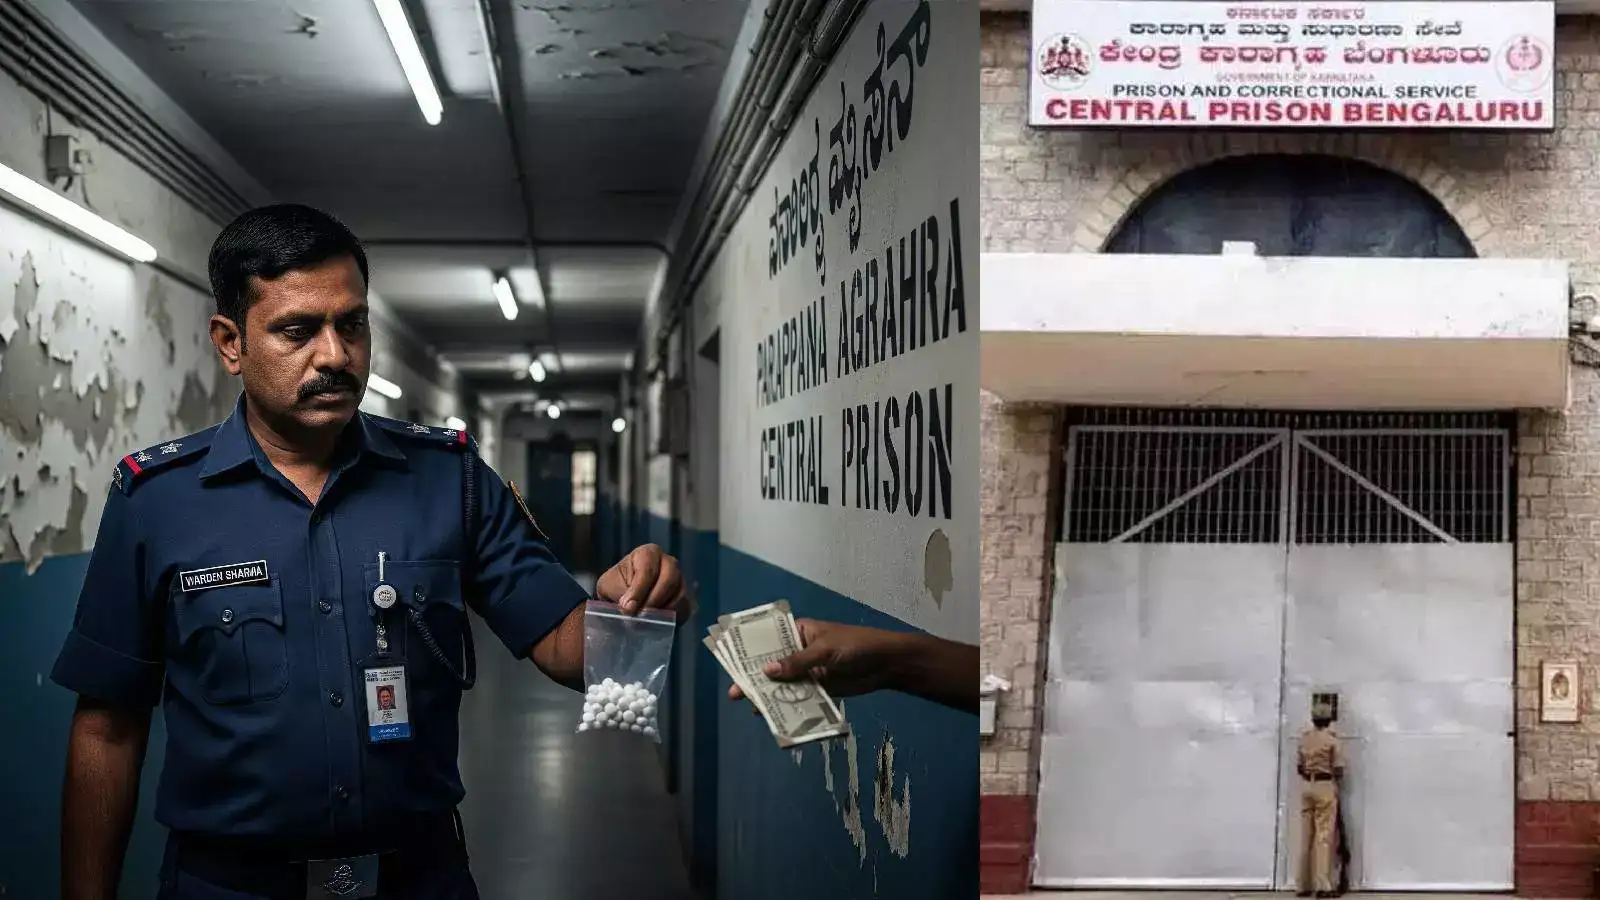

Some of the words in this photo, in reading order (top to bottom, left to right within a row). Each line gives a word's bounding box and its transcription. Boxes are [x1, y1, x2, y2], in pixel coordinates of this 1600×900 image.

[1129, 22, 1227, 41] ಕಾರಾಗೃಹ
[1237, 22, 1291, 43] ಮತ್ತು
[1301, 22, 1404, 38] ಸುಧಾರಣಾ
[1415, 19, 1463, 37] ಸೇವೆ
[1099, 37, 1182, 70] ಕೇಂದ್ರ
[1200, 44, 1327, 71] ಕಾರಾಗೃಹ
[1343, 40, 1491, 64] ಬೆಂಗಳೂರು
[1216, 71, 1289, 83] GOVERNMENT
[1293, 72, 1307, 82] OF
[1112, 84, 1186, 98] PRISON
[1190, 84, 1232, 98] AND
[1236, 84, 1388, 98] CORRECTIONAL
[1395, 84, 1477, 98] SERVICE
[1045, 98, 1197, 121] CENTRAL
[1208, 100, 1332, 122] PRISON
[1342, 101, 1543, 122] BENGALURU
[756, 296, 829, 409] PARAPPANA
[837, 197, 967, 379] AGRAHRA
[760, 414, 829, 506] CENTRAL
[841, 383, 953, 520] PRISON
[185, 571, 223, 587] WARDEN
